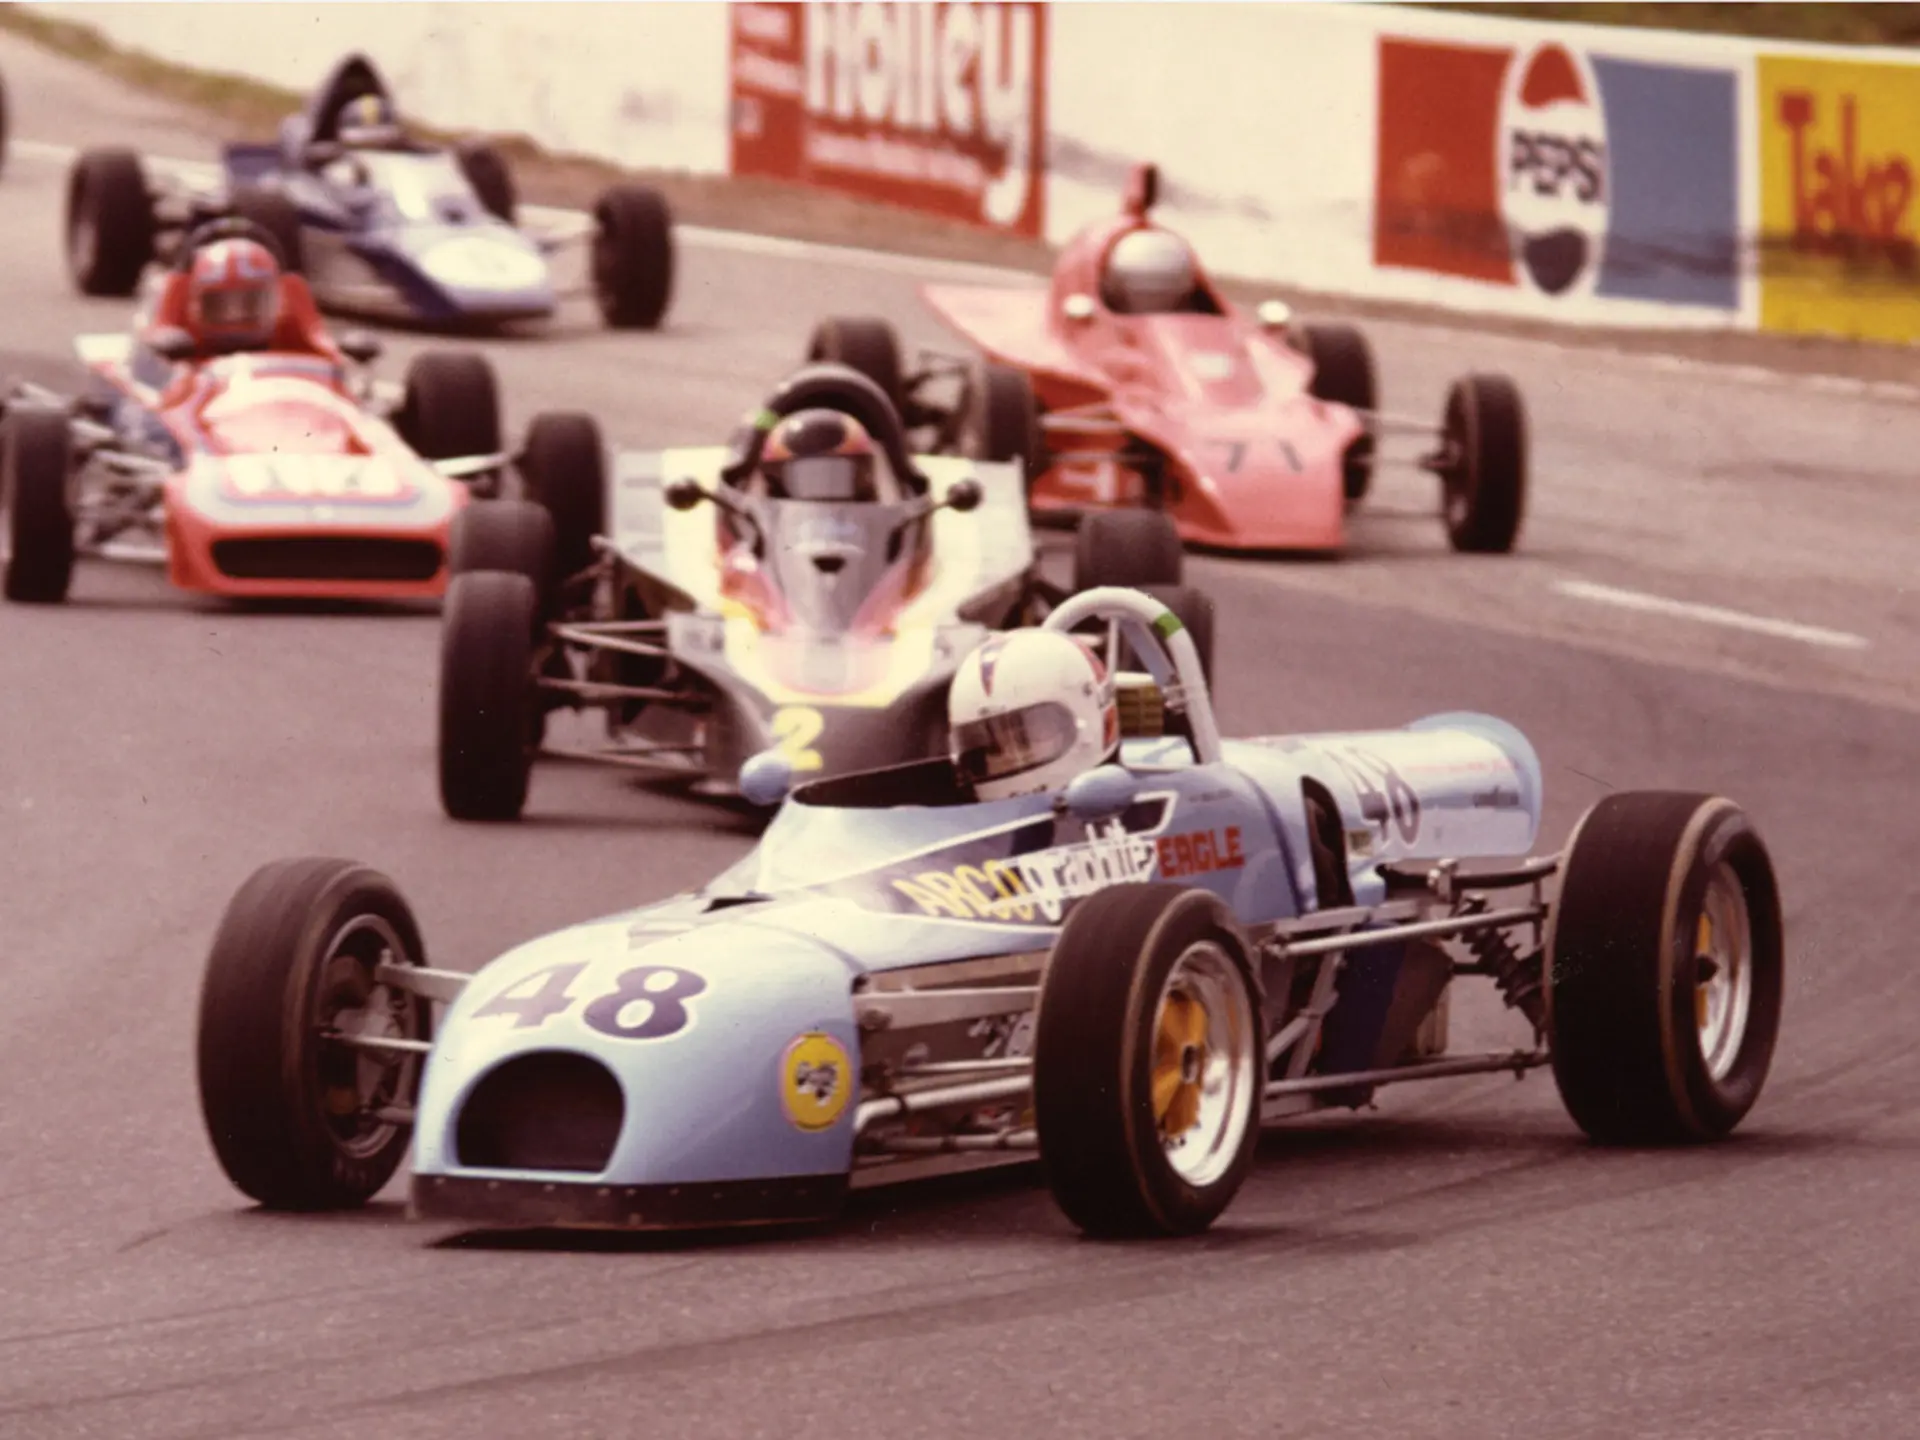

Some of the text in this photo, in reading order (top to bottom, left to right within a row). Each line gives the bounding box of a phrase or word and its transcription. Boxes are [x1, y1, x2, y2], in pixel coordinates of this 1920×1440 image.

[1510, 128, 1606, 206] PEPS
[1776, 88, 1912, 266] Take
[771, 706, 825, 771] 2
[1321, 745, 1420, 845] 48
[893, 858, 1036, 922] ARCO
[1155, 826, 1246, 879] EAGLE
[470, 960, 707, 1039] 48
